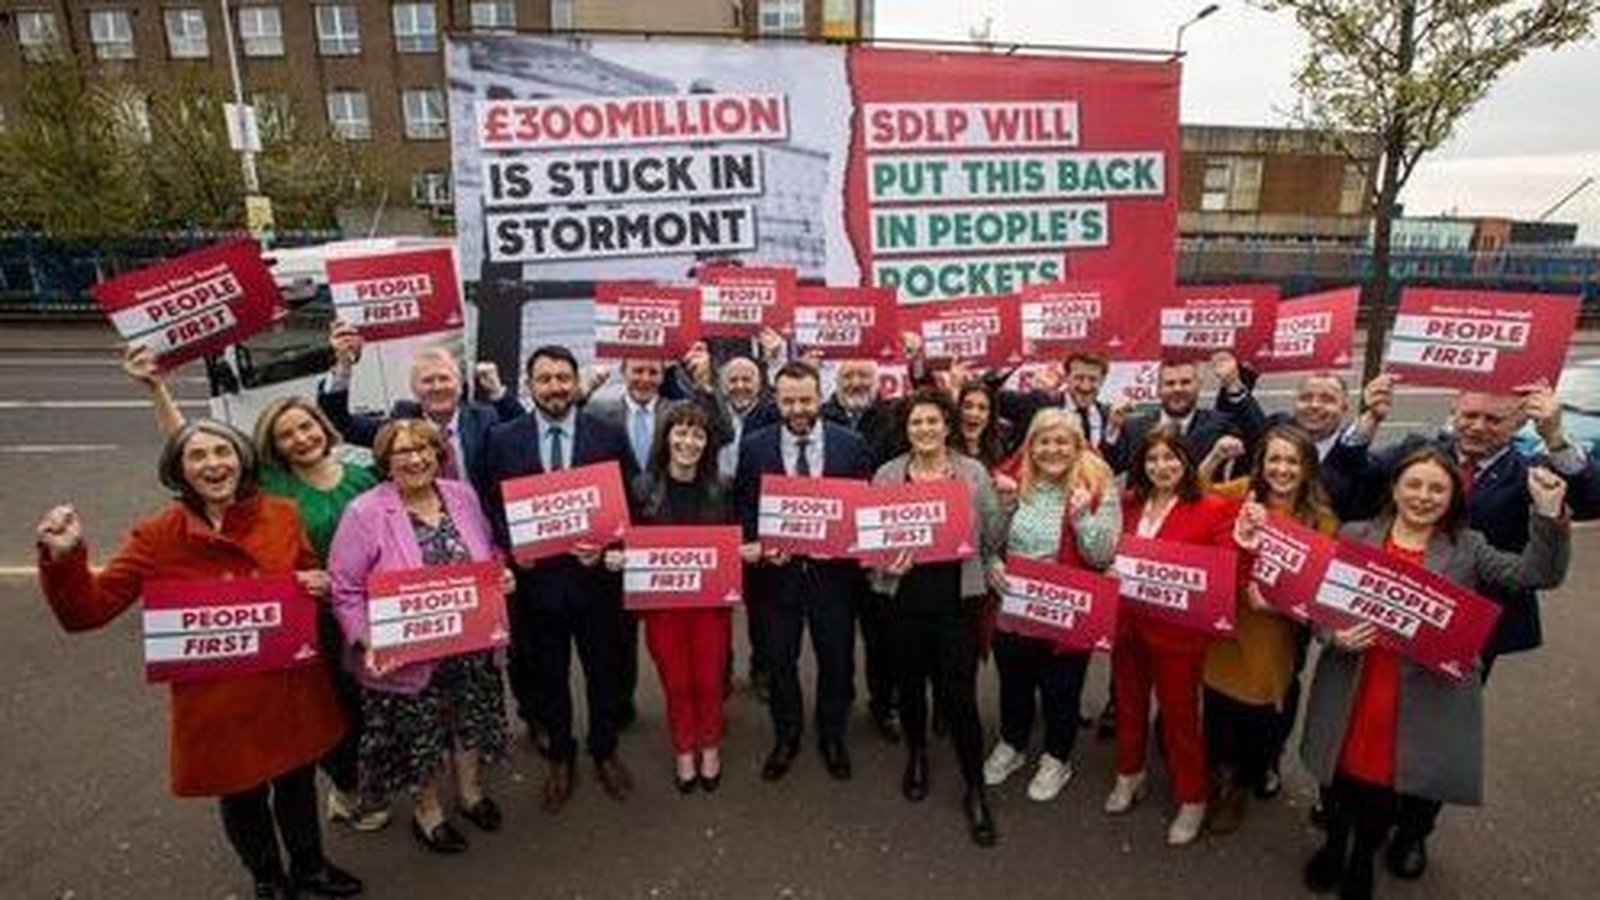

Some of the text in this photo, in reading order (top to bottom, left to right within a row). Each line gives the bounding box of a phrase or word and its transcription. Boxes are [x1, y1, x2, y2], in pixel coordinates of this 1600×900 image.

[484, 97, 781, 141] £300MILLION
[871, 108, 1072, 143] SDLP WILL
[489, 154, 754, 199] IS STUCK IN
[873, 158, 1157, 196] PUT THIS BACK
[497, 209, 746, 256] STORMONT
[875, 209, 1103, 248] IN PEOPLE'S
[145, 278, 237, 323] PEOPLE
[357, 278, 428, 298] PEOPLE
[363, 303, 416, 320] FIRST
[1426, 319, 1525, 344] PEOPLE
[1421, 346, 1490, 367] FIRST
[1348, 595, 1410, 630] FIRST
[1358, 573, 1447, 624] PEOPLE
[181, 605, 278, 629] PEOPLE
[182, 635, 254, 656] FIRST
